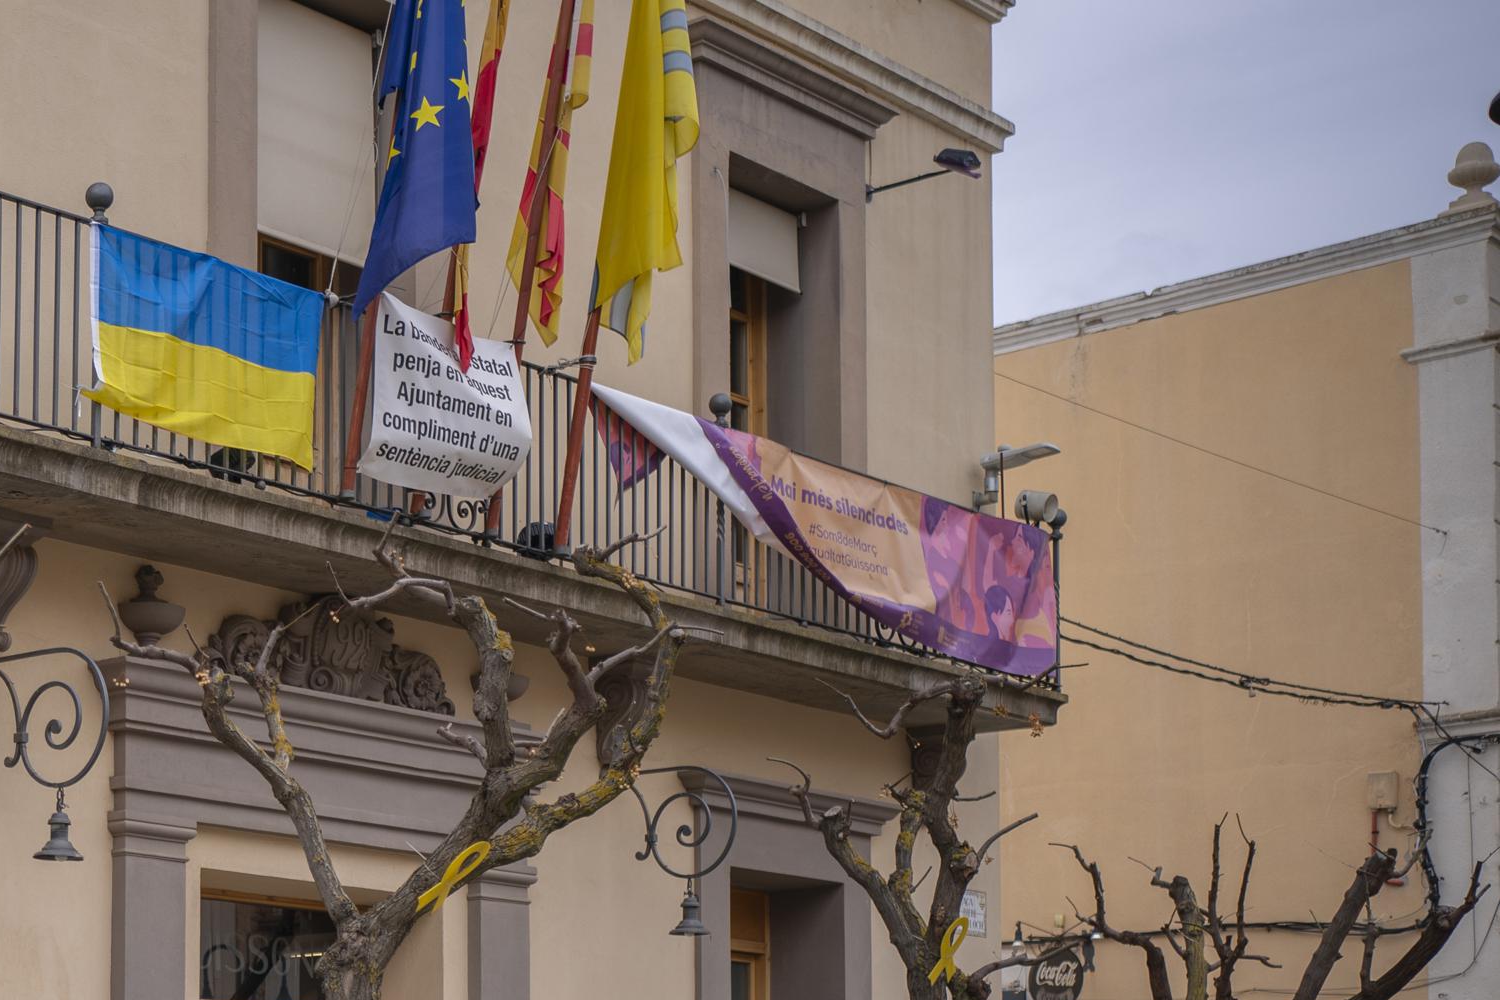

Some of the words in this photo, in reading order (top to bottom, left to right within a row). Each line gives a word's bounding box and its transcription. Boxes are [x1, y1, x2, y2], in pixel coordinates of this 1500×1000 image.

[383, 314, 406, 336] La
[468, 355, 514, 378] statal
[393, 352, 441, 379] penja
[446, 365, 464, 383] en
[466, 375, 513, 402] aquest
[397, 381, 492, 422] Ajuntament
[495, 409, 512, 428] en
[383, 411, 476, 450] compliment
[479, 434, 519, 461] d'una
[376, 442, 451, 474] sentència
[446, 458, 506, 485] judicial
[771, 474, 797, 501] Mai
[801, 489, 833, 511] més
[835, 499, 909, 535] silenciades
[809, 523, 878, 558] #Som8deMarç
